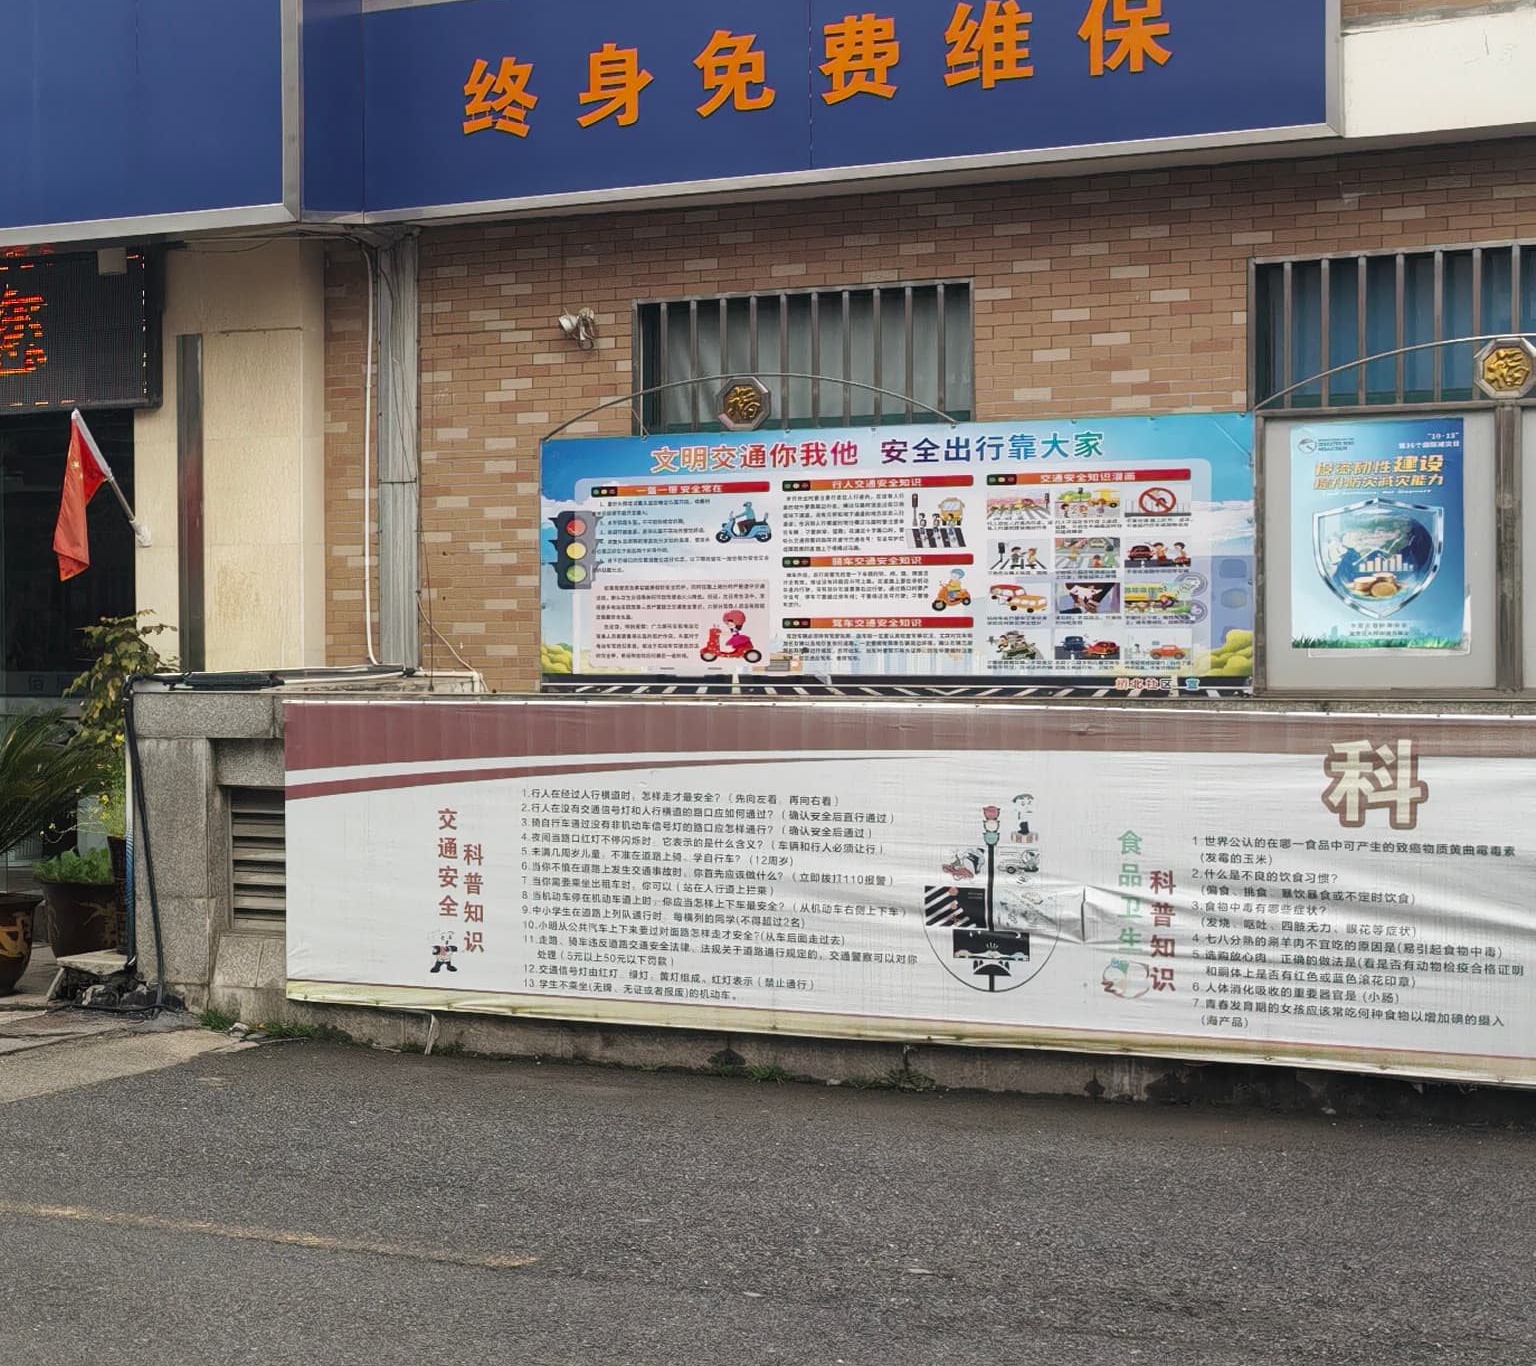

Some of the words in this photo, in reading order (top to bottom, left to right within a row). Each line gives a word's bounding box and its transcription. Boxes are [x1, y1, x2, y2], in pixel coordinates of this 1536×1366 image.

[650, 440, 859, 473] 文明交通你我他
[880, 431, 1104, 465] 安全出行靠大家
[831, 478, 922, 489] 行人交通安全知识
[1322, 736, 1428, 830] 科
[437, 808, 459, 918] 交通安全
[463, 843, 485, 953] 科普知识
[1117, 829, 1143, 953] 食品卫生
[1149, 869, 1176, 992] 科普知识
